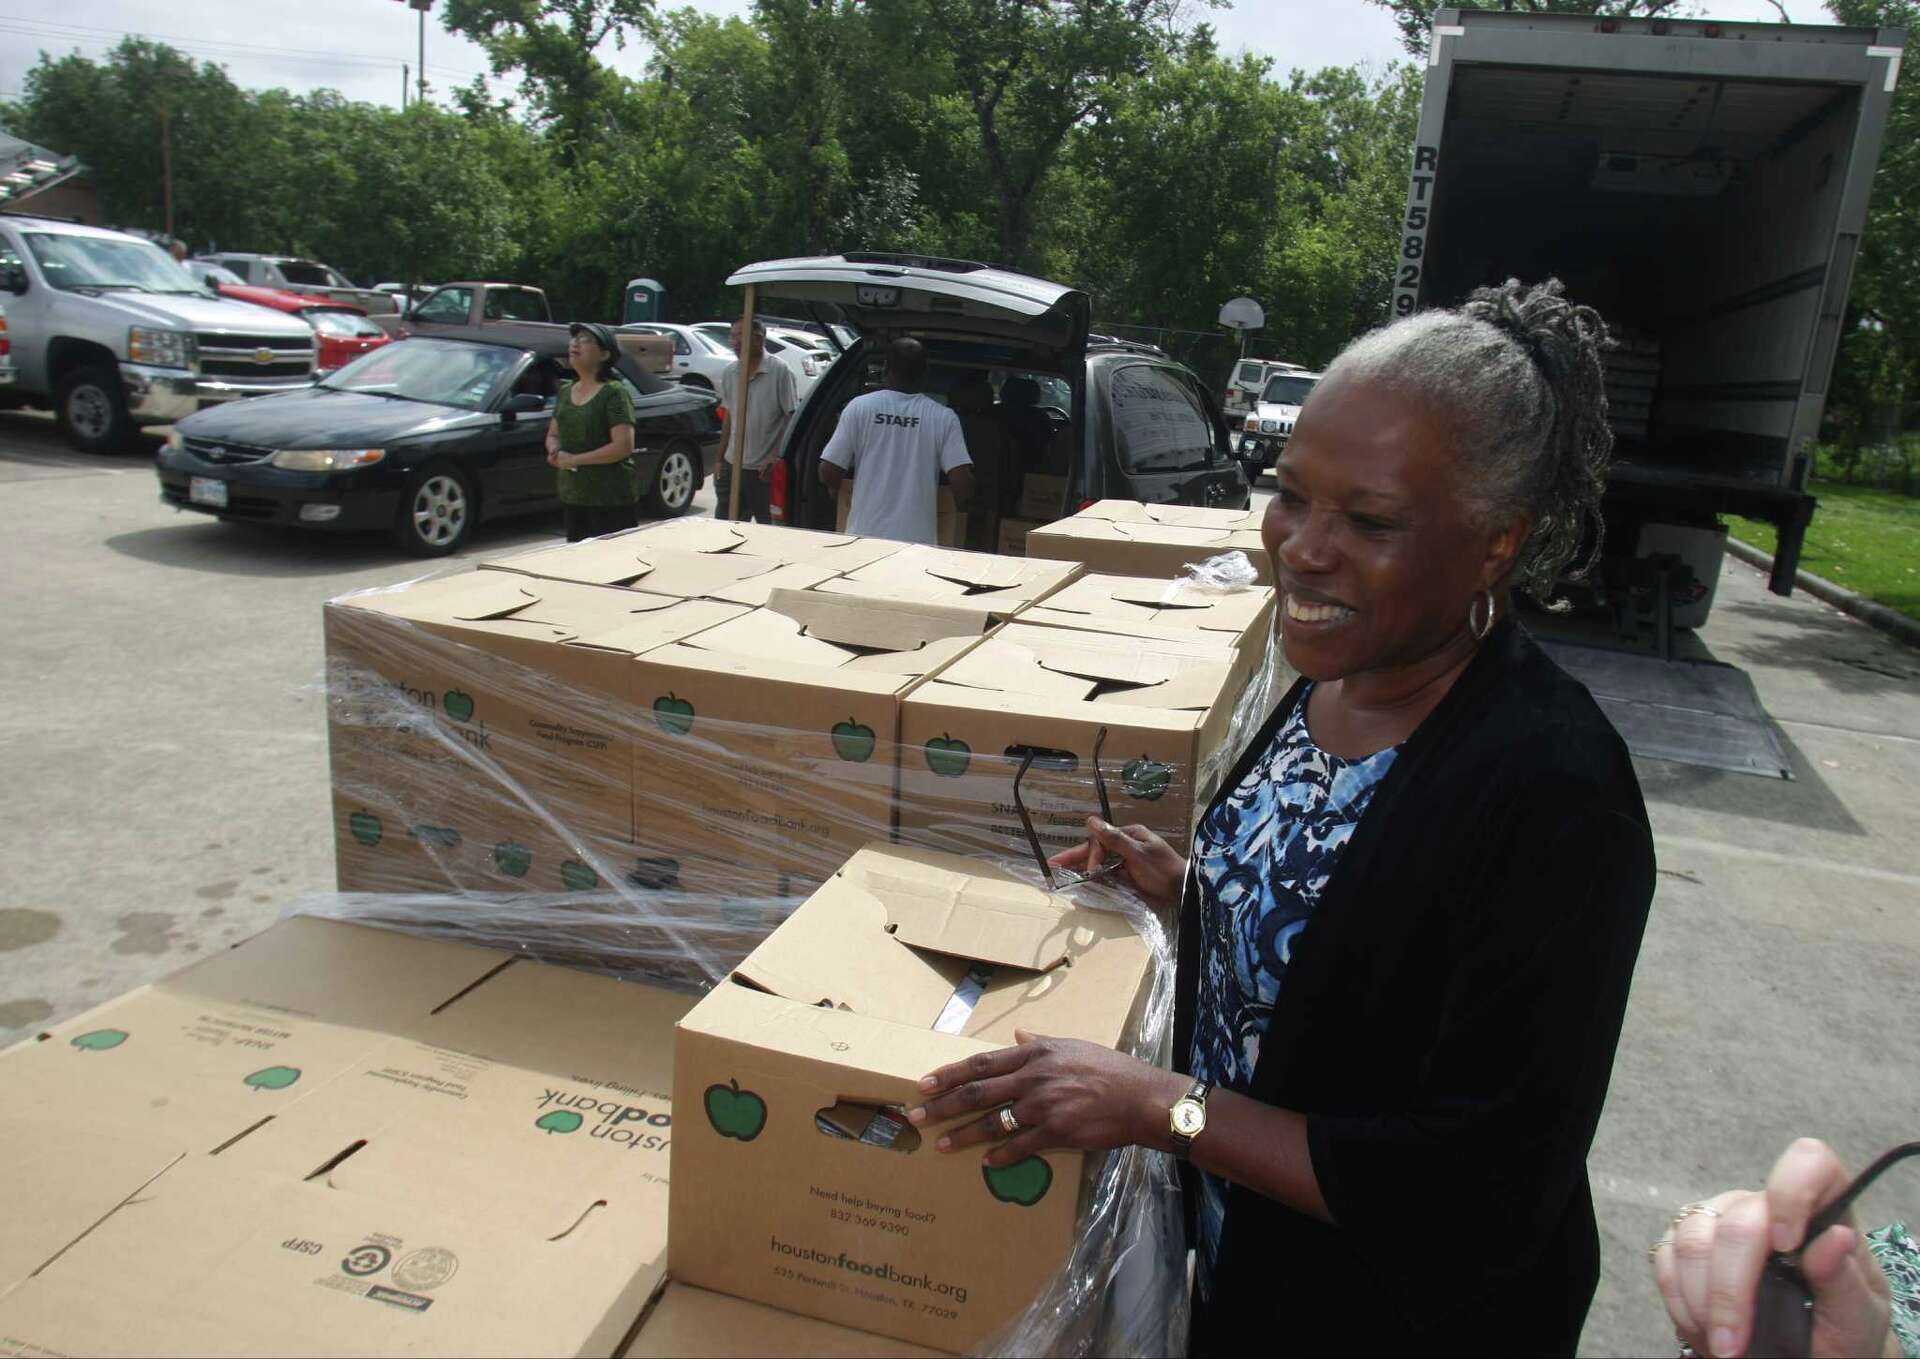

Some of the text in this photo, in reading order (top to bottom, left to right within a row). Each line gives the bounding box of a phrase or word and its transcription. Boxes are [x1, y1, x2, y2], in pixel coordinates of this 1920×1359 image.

[874, 413, 920, 428] STAFF
[605, 1081, 648, 1097] Filling
[535, 1088, 671, 1128] odbank
[809, 1184, 936, 1224] Need help buying food?
[830, 1208, 909, 1236] 832 369 9390
[281, 1238, 324, 1256] CSFP
[770, 1234, 968, 1303] houstonfoodbank.org
[921, 1304, 959, 1320] 77029
